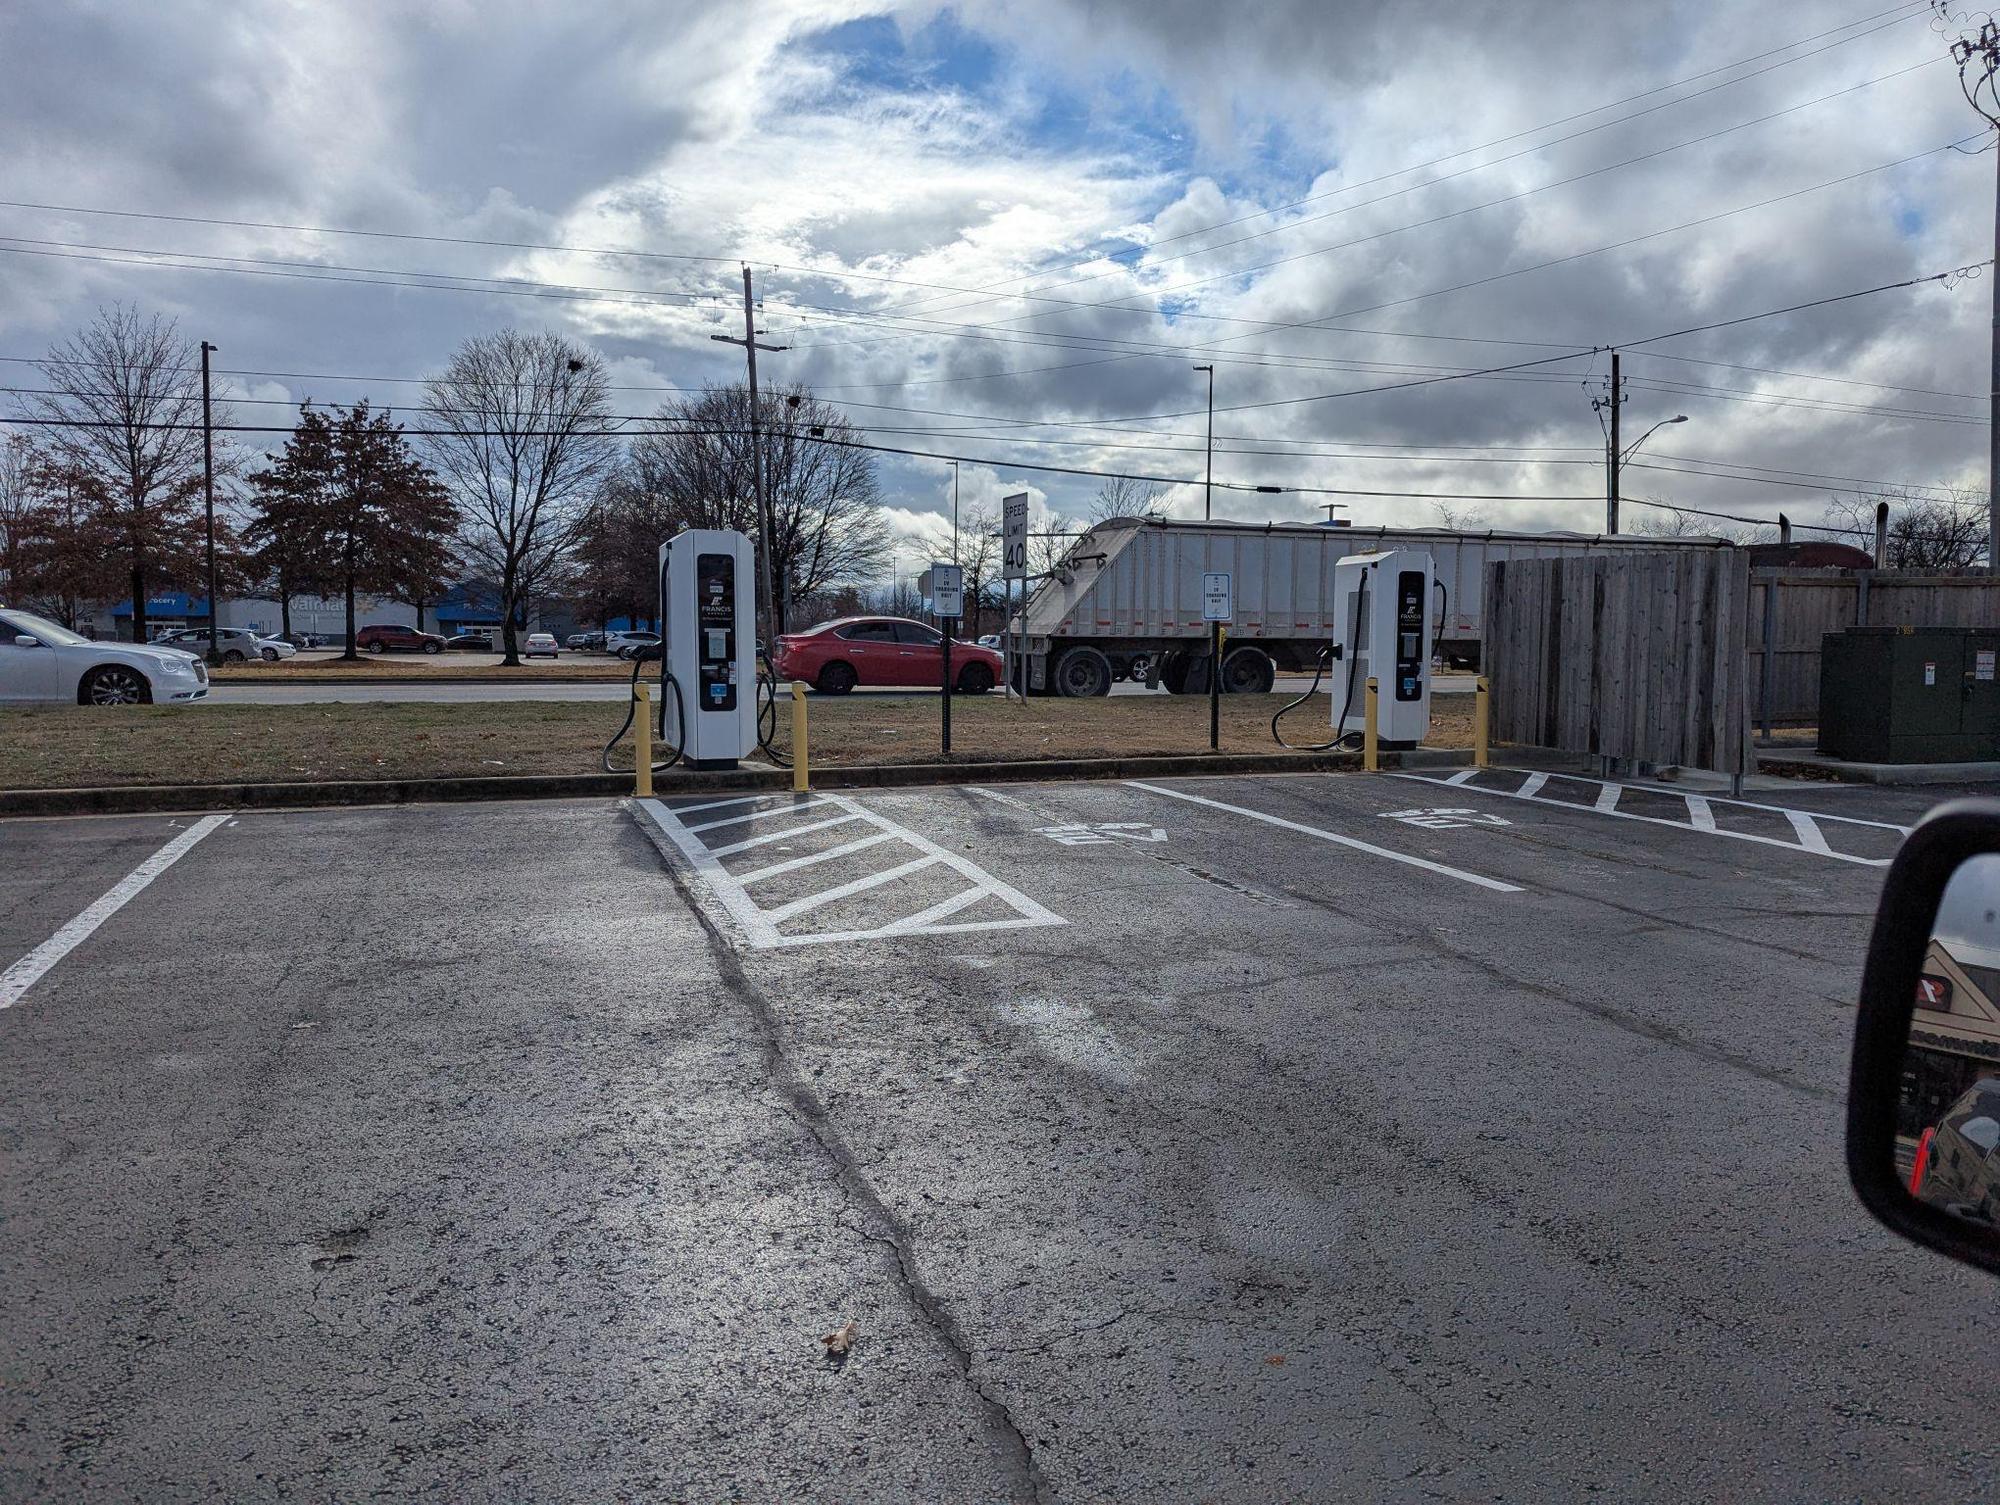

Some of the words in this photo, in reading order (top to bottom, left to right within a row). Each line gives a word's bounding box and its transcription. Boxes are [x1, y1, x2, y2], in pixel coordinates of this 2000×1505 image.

[1005, 503, 1026, 519] SPEED
[1007, 523, 1024, 538] LIMIT
[1006, 542, 1025, 570] 40
